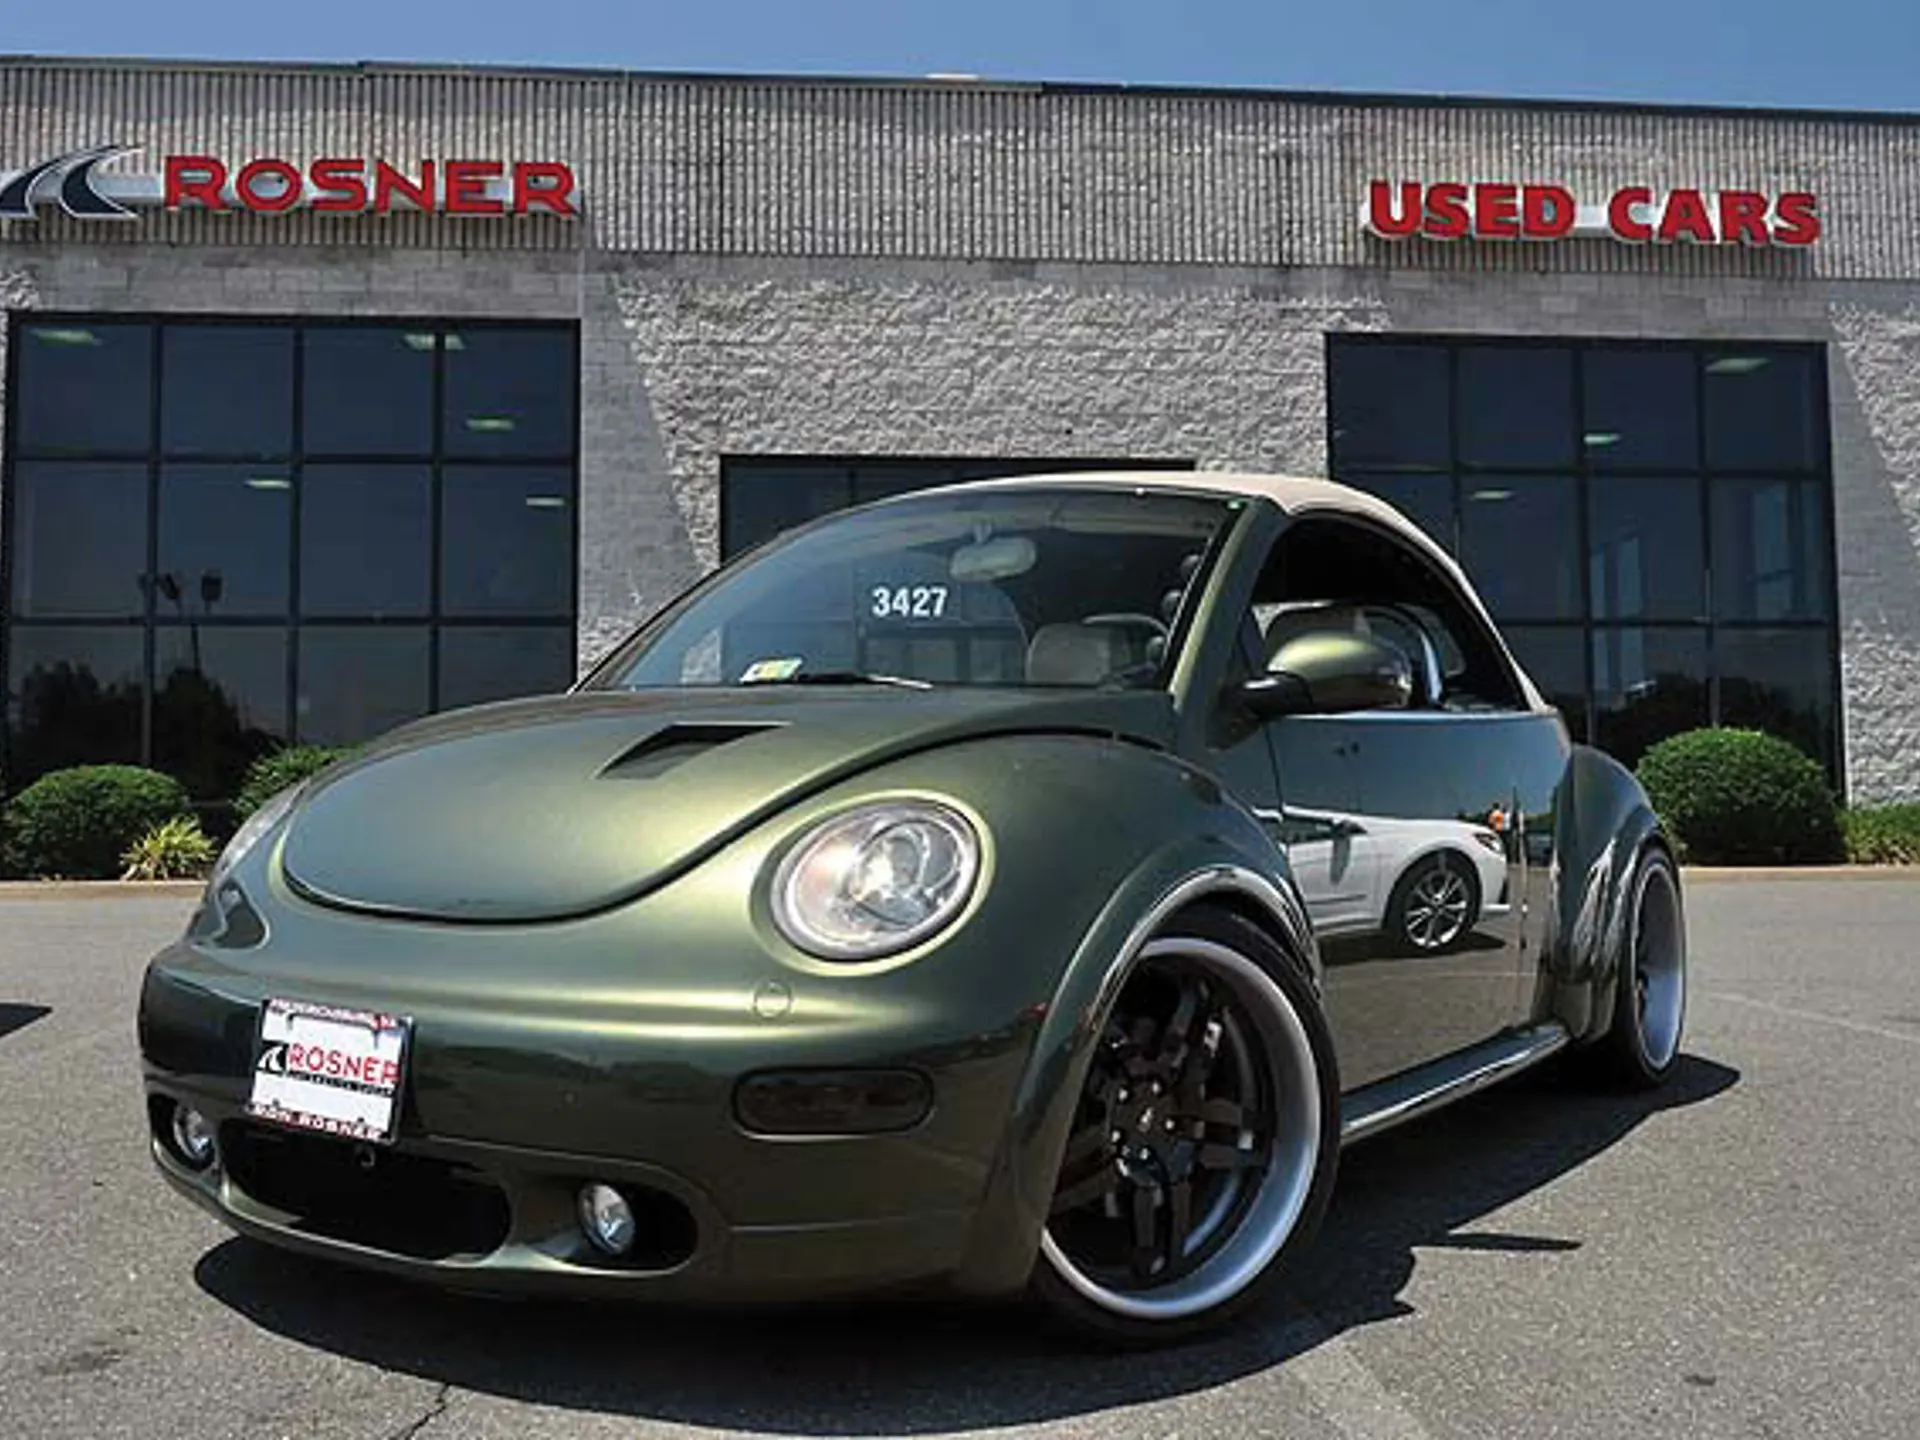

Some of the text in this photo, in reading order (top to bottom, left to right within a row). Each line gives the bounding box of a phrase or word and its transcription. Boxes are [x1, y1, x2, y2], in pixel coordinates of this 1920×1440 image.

[163, 155, 579, 216] ROSNER
[1368, 180, 1823, 245] USED CARS
[872, 586, 948, 618] 3427
